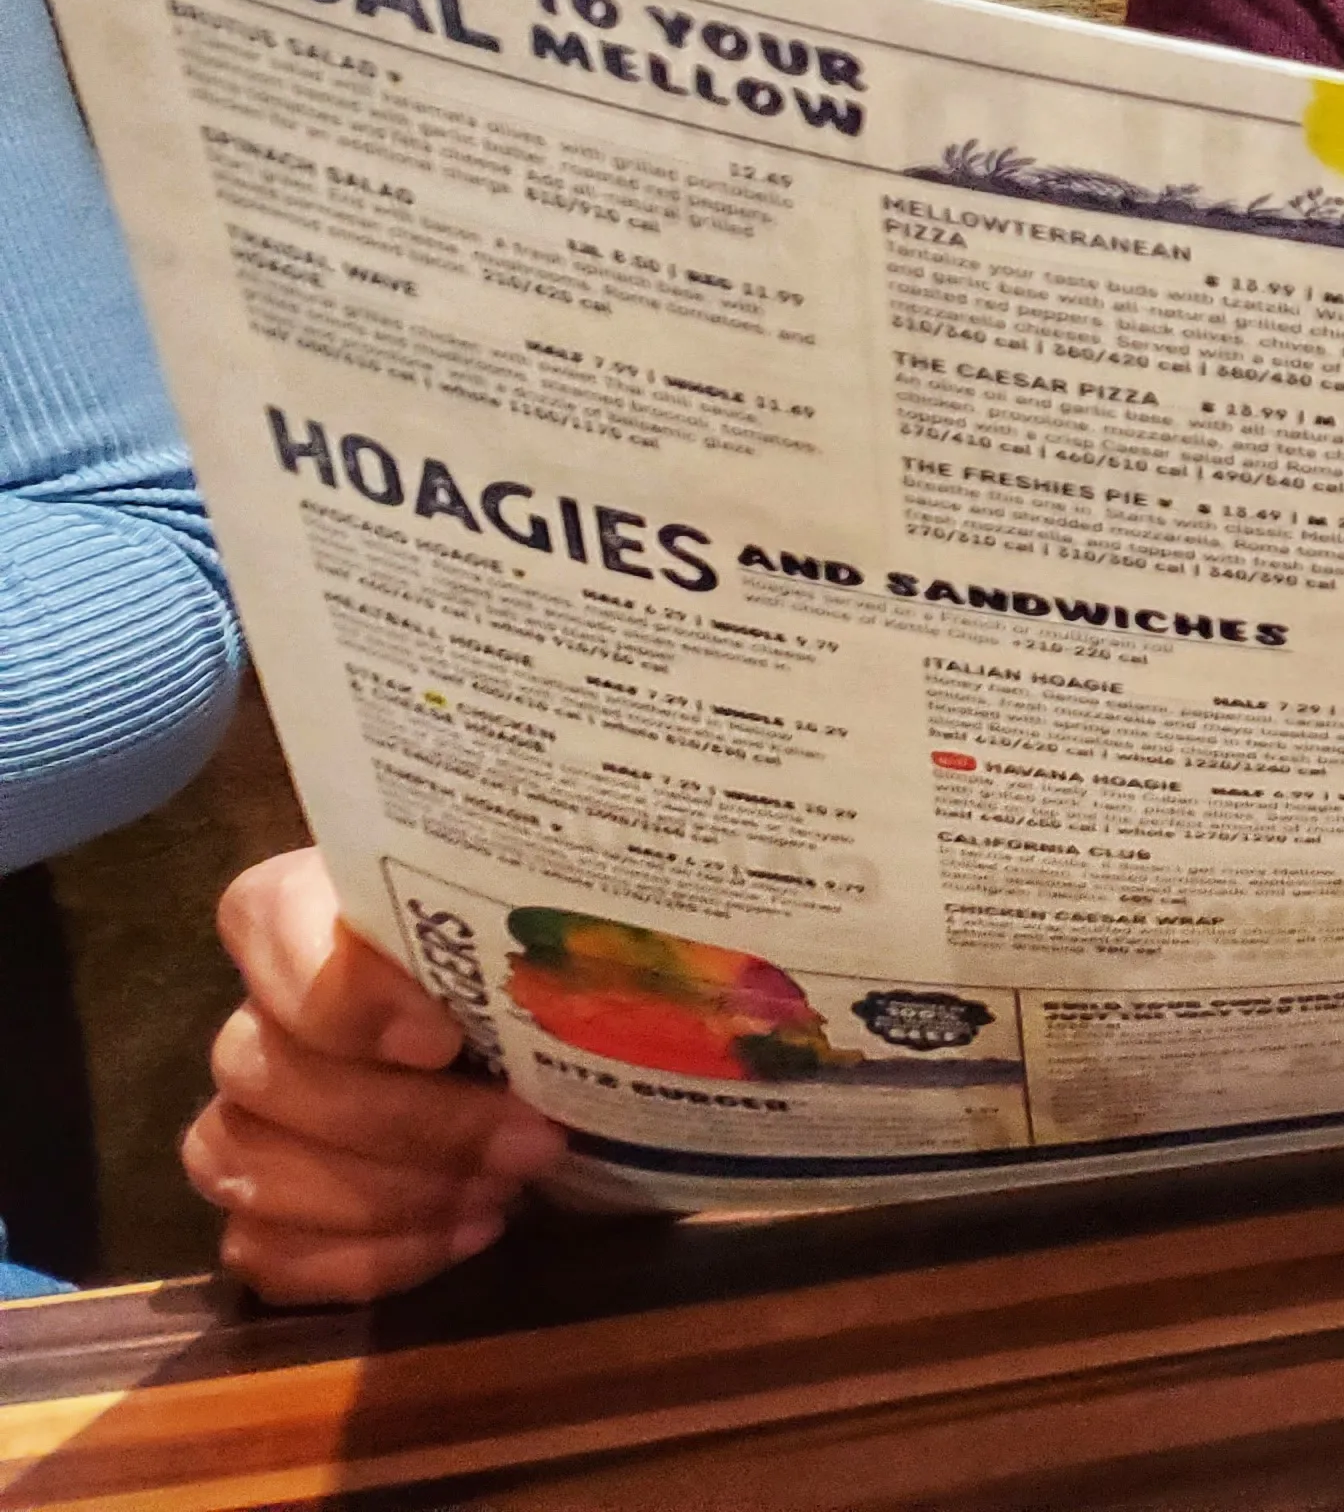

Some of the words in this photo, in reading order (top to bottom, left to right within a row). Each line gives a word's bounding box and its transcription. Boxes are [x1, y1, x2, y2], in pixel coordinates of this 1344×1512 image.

[645, 5, 868, 92] YOUR
[531, 21, 865, 136] MELLOW
[883, 194, 1192, 261] MELLOWTERRANEAN
[884, 218, 968, 249] PIZZA
[989, 263, 1034, 280] your
[1168, 290, 1214, 305] with
[1059, 293, 1105, 309] with
[893, 350, 947, 374] THE
[956, 362, 1068, 393] CAESAR
[1079, 381, 1159, 406] PIZZA
[264, 404, 720, 592] HOAGIES
[901, 455, 953, 478] THE
[963, 467, 1095, 500] FRESHIES
[1106, 487, 1149, 507] PIE
[737, 543, 864, 586] AND
[885, 570, 1291, 647] SANDWICHES
[923, 656, 1022, 681] ITALIAN
[1031, 671, 1124, 694] HOAGIE
[985, 761, 1085, 784] HAVANA
[1092, 774, 1181, 792] HOAGIE
[937, 831, 1080, 856] CALIFORNIA
[1088, 846, 1152, 860] CLUB
